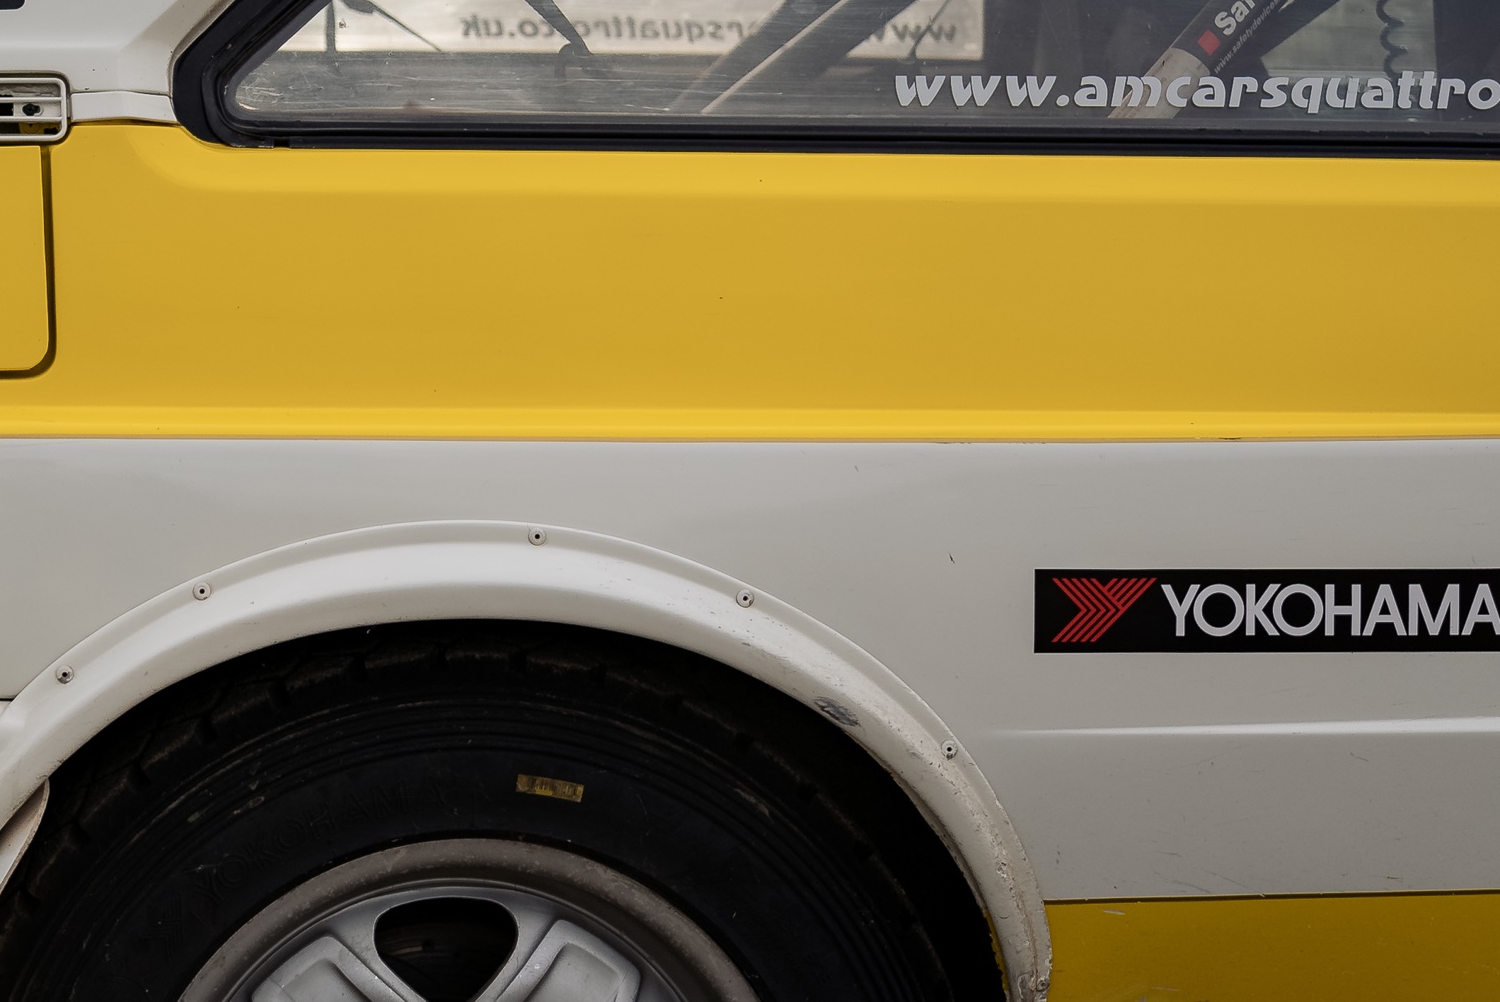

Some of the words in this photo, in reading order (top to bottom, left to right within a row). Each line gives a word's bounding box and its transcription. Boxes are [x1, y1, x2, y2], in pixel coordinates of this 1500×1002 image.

[895, 70, 1500, 114] www.amcarsquattro
[1161, 583, 1500, 637] YOKOHAMA
[192, 776, 448, 905] YOKOHAMA
